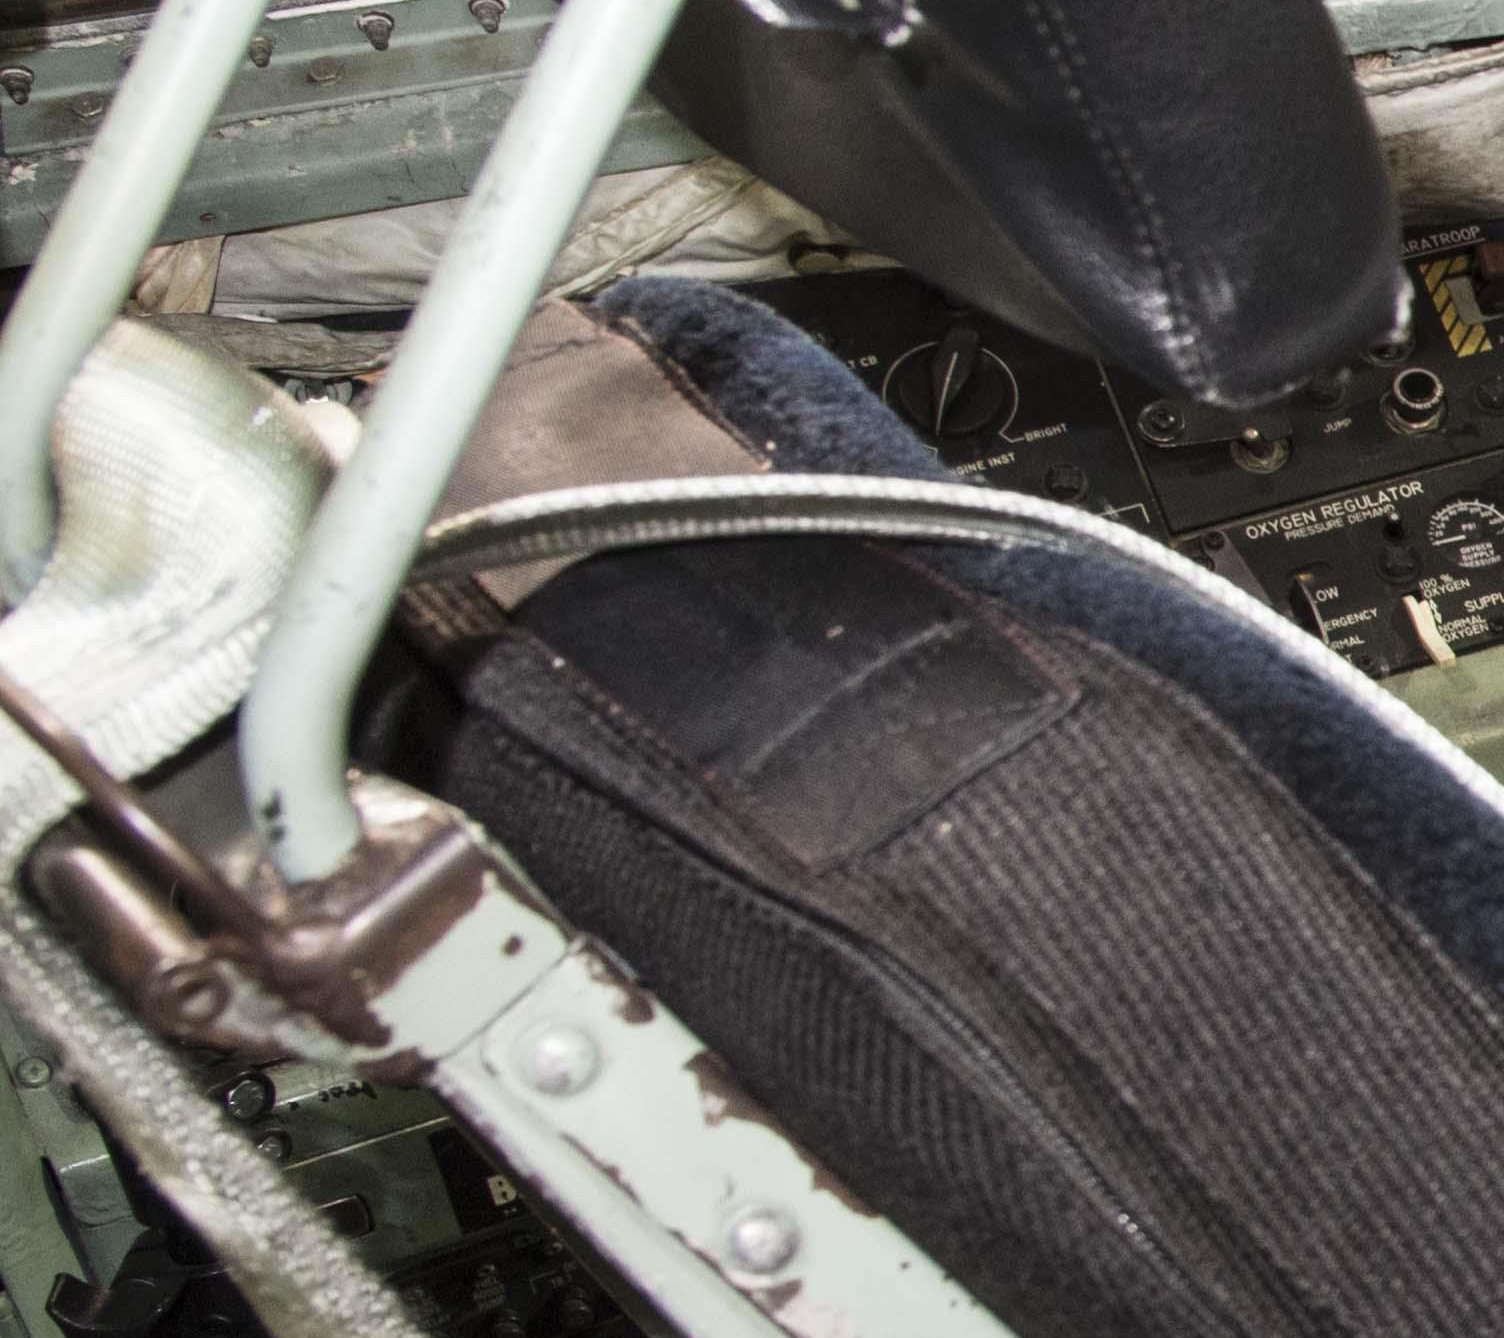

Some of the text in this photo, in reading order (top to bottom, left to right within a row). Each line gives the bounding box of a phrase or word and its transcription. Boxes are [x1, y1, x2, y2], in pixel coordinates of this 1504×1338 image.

[1025, 423, 1068, 444] BRIGHT
[1323, 418, 1353, 434] JUMP
[1246, 481, 1425, 539] OXYGEN REGULATOR
[1424, 579, 1471, 599] OXYGEN
